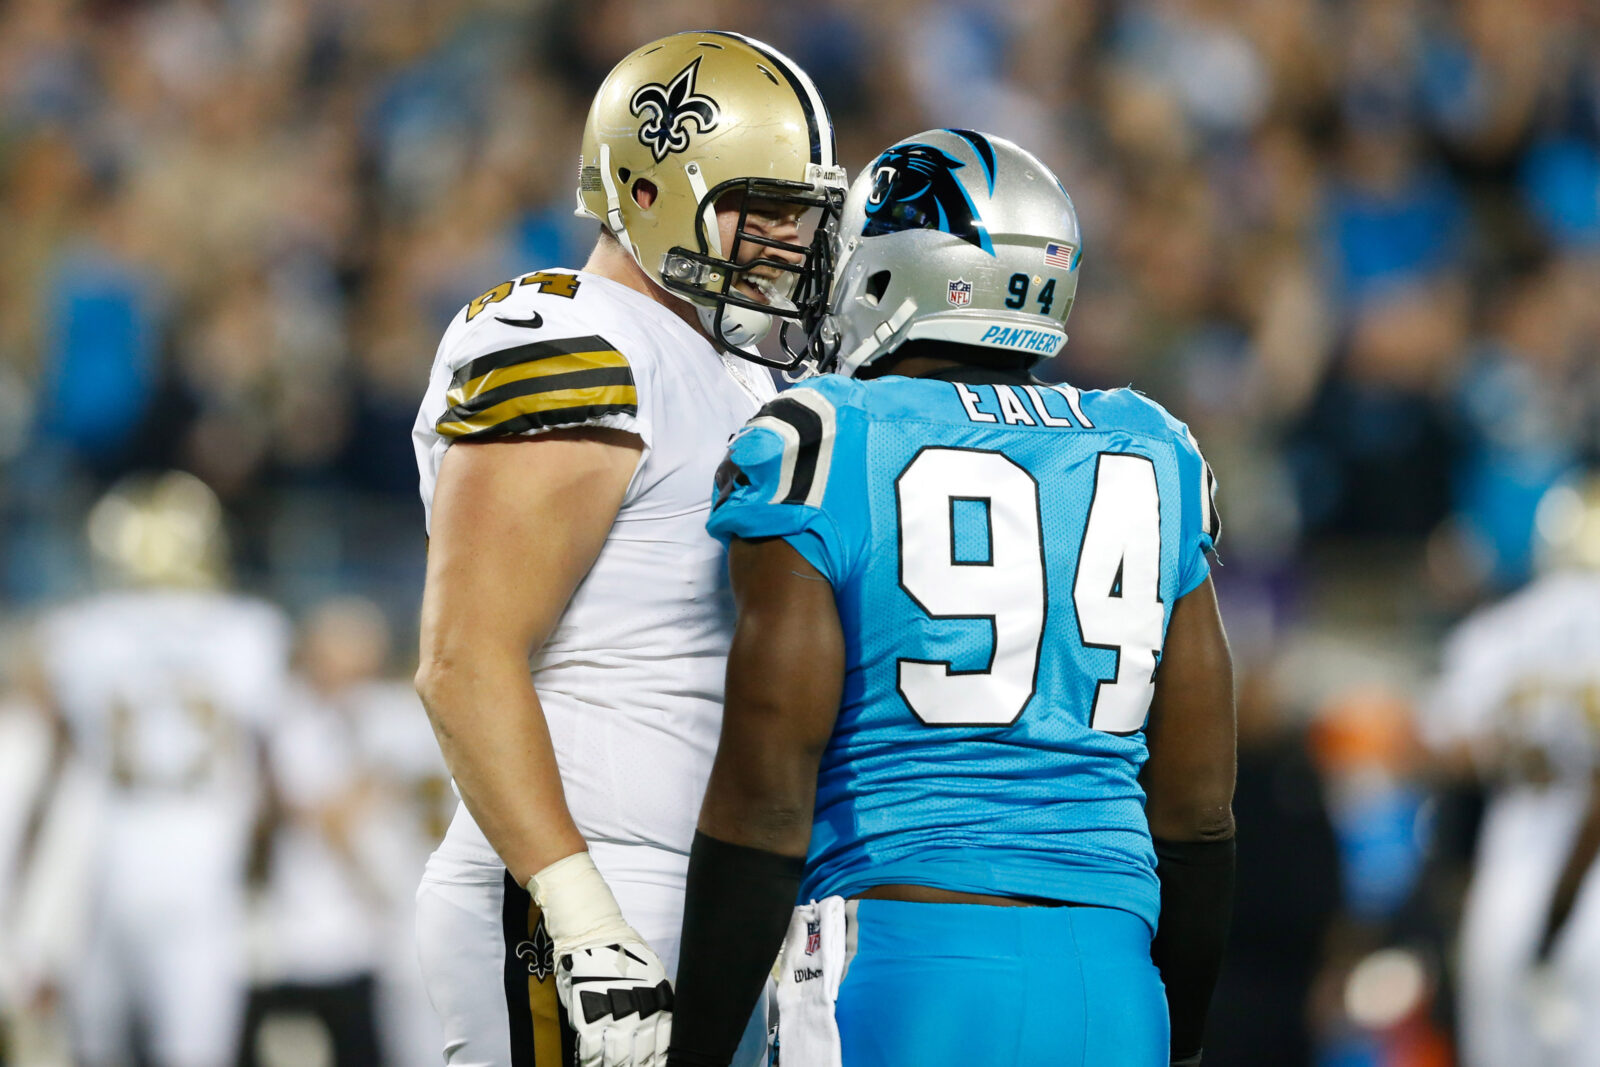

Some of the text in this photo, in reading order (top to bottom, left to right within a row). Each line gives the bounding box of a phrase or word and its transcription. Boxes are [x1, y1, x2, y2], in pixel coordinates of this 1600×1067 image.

[950, 290, 968, 304] NFL
[1004, 272, 1057, 315] 94
[980, 325, 1062, 353] PANTHERS
[951, 382, 1096, 429] EALY
[894, 445, 1164, 735] 94
